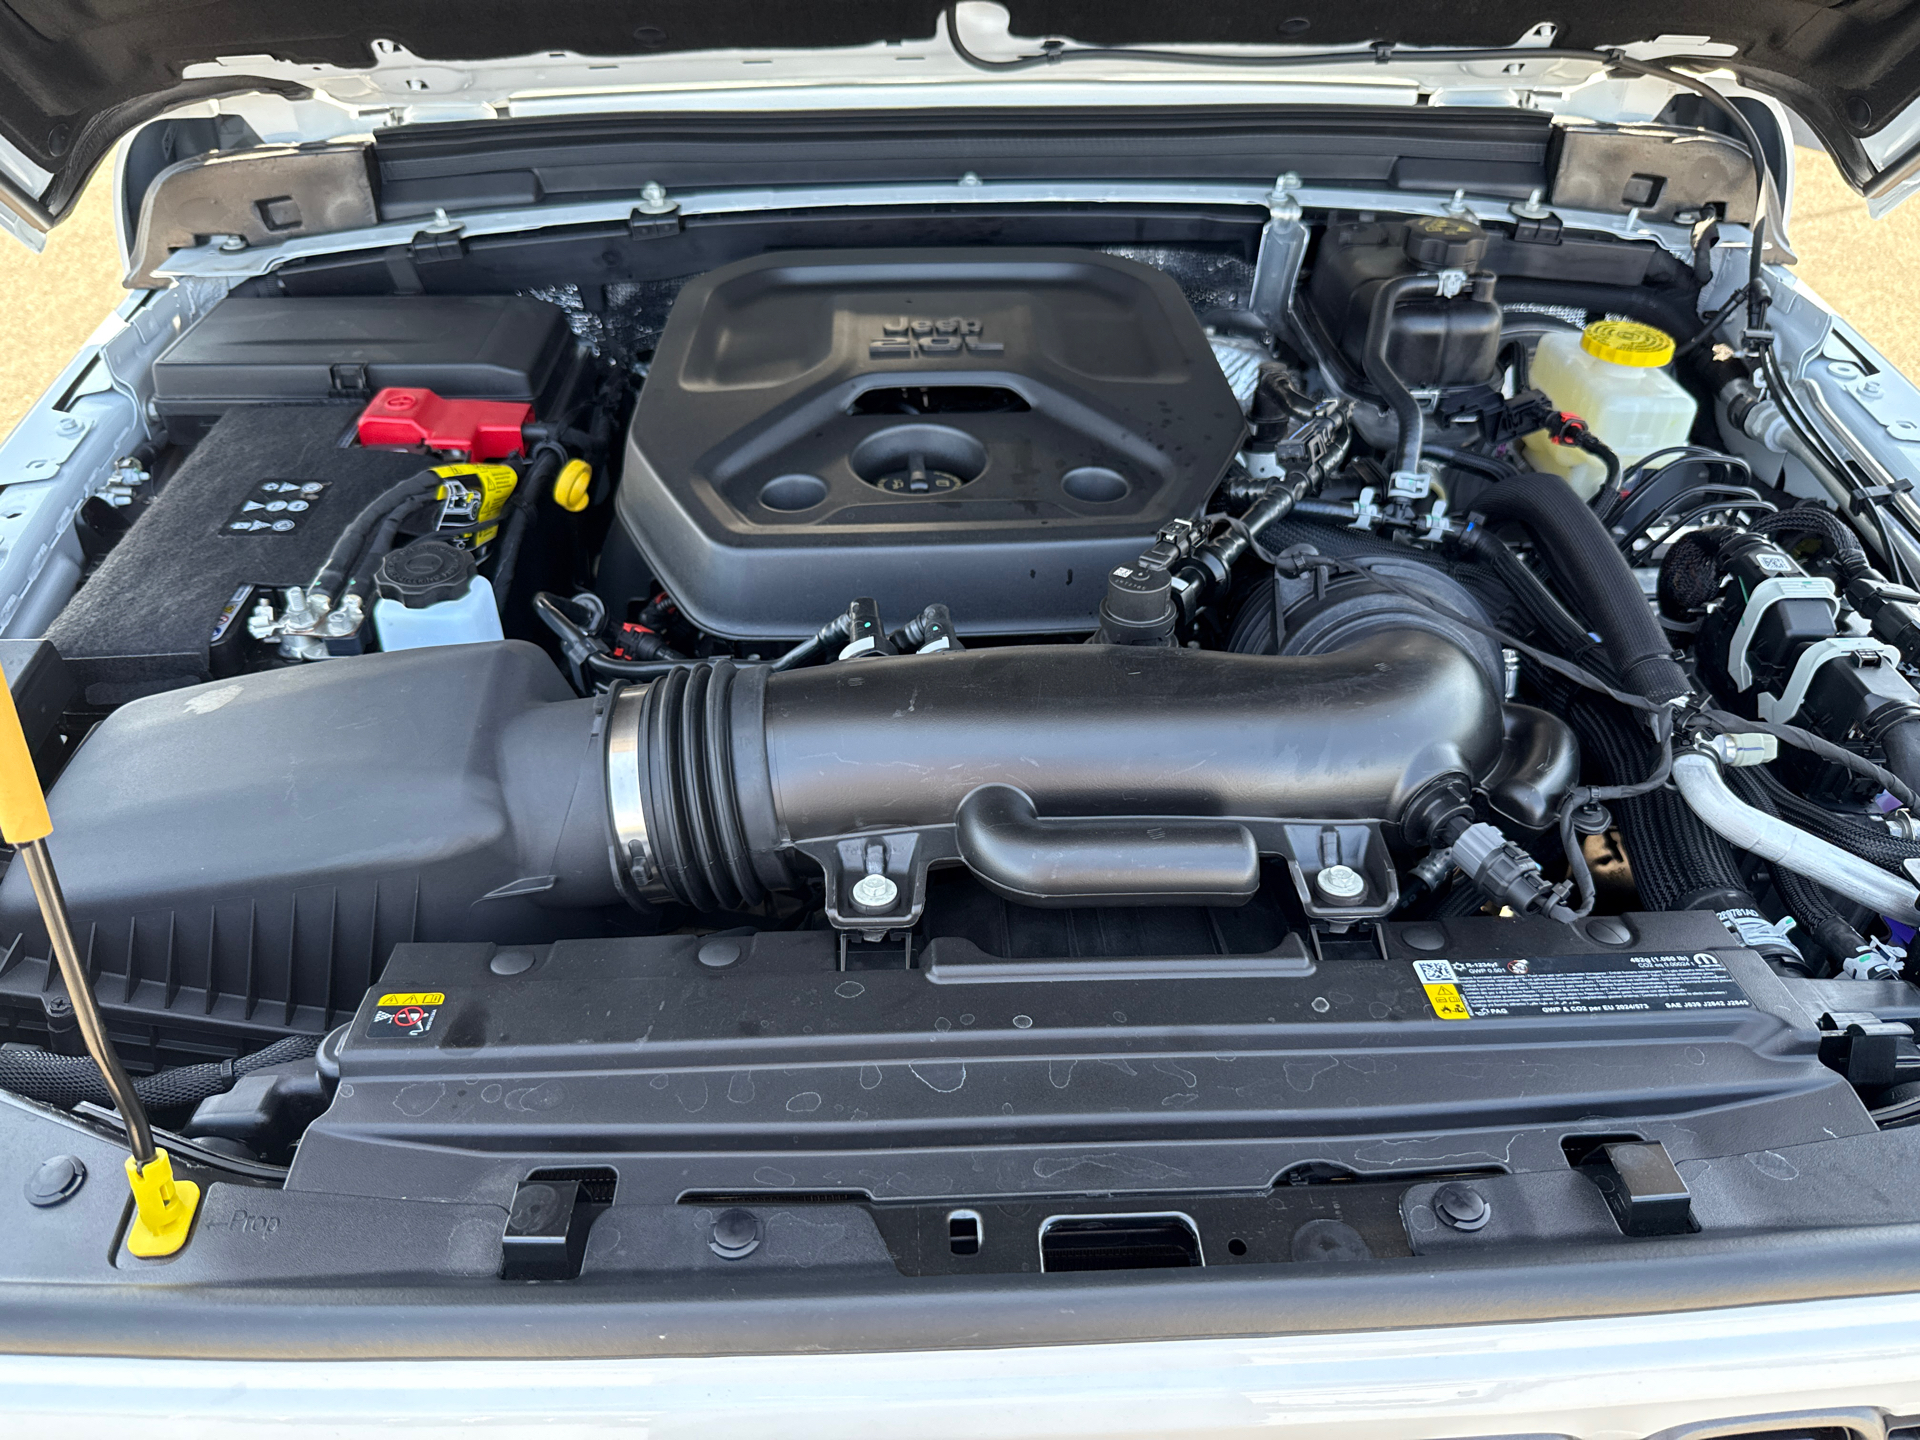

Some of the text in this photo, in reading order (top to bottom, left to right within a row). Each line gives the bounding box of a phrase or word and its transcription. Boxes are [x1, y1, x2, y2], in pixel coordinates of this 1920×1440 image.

[883, 316, 984, 338] Jeep
[869, 337, 1004, 359] 2.0L
[229, 1209, 280, 1240] Prop
